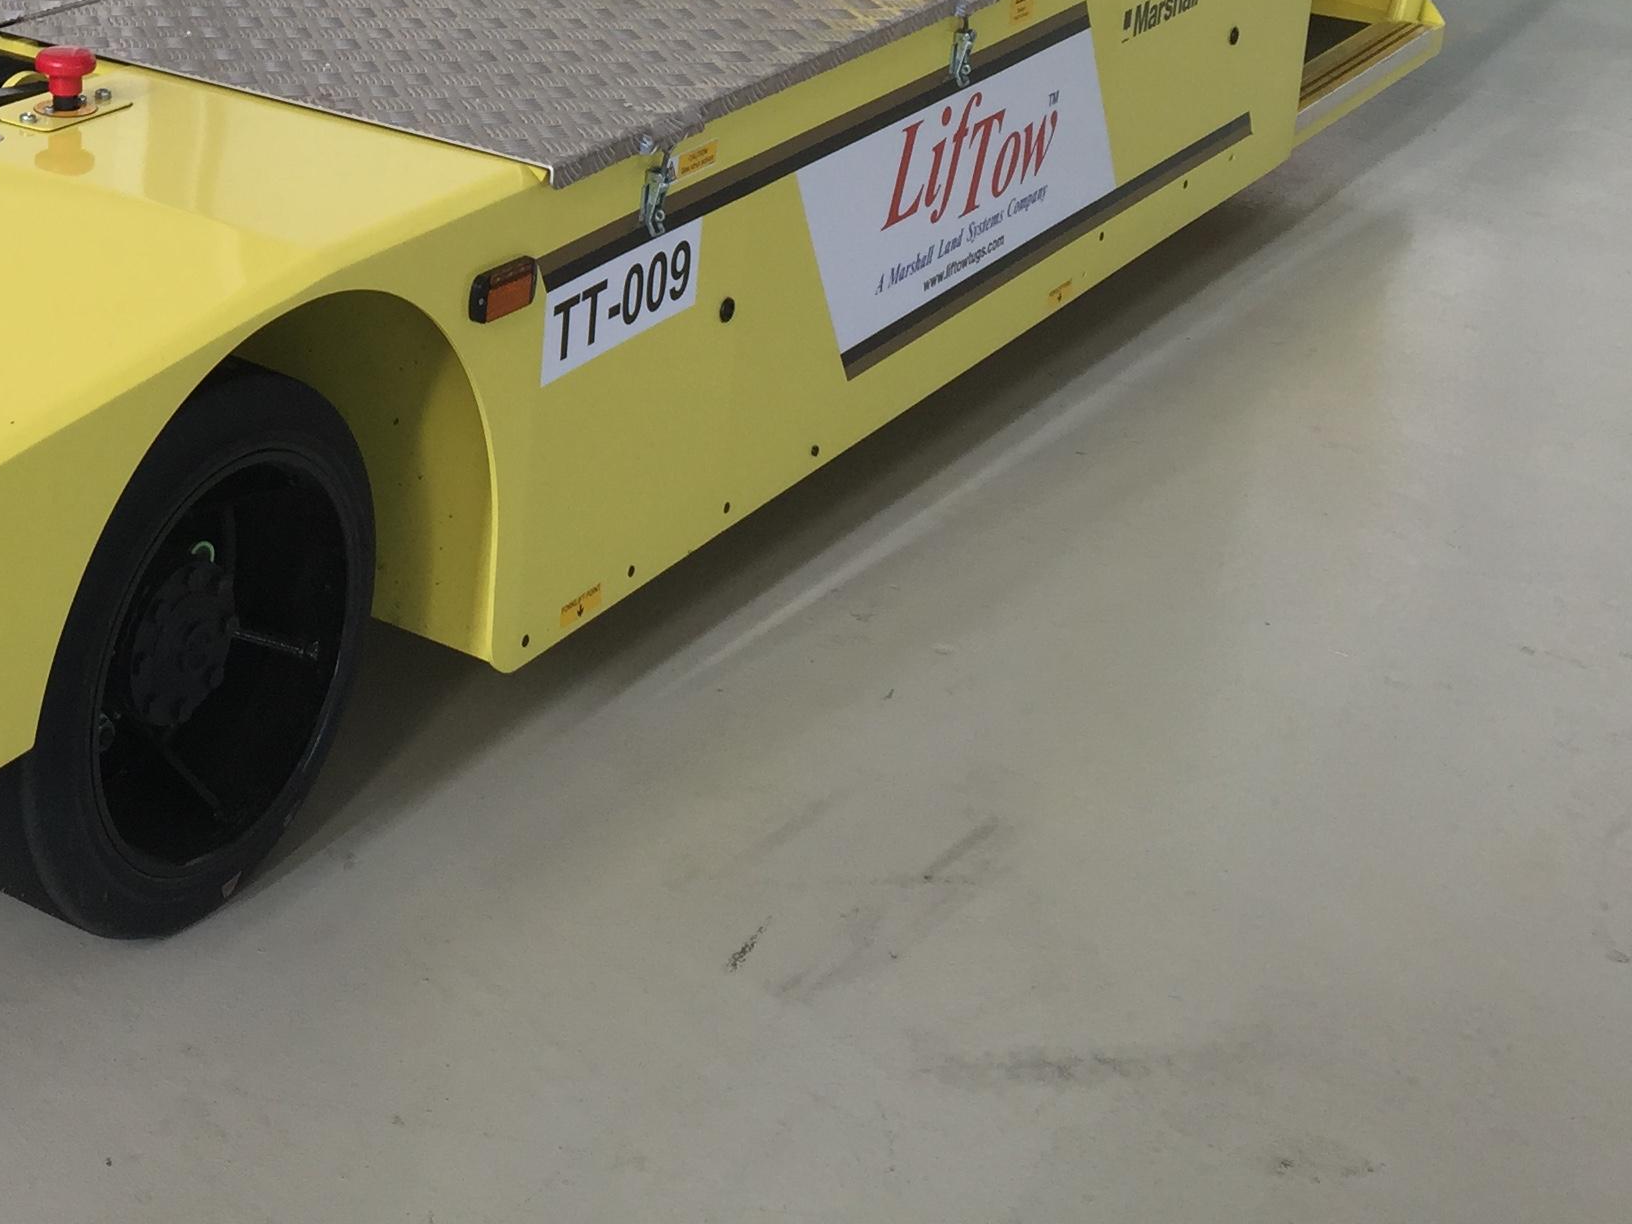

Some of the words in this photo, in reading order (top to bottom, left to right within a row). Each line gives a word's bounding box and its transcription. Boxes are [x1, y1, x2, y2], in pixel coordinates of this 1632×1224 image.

[880, 92, 1058, 232] LifTow
[874, 273, 885, 295] A
[888, 244, 935, 289] Marshall
[937, 228, 964, 259] Land
[966, 210, 1004, 243] Systems
[1007, 184, 1048, 217] Company
[923, 235, 1005, 291] www.liftowtugs.com
[553, 240, 691, 361] TT-009
